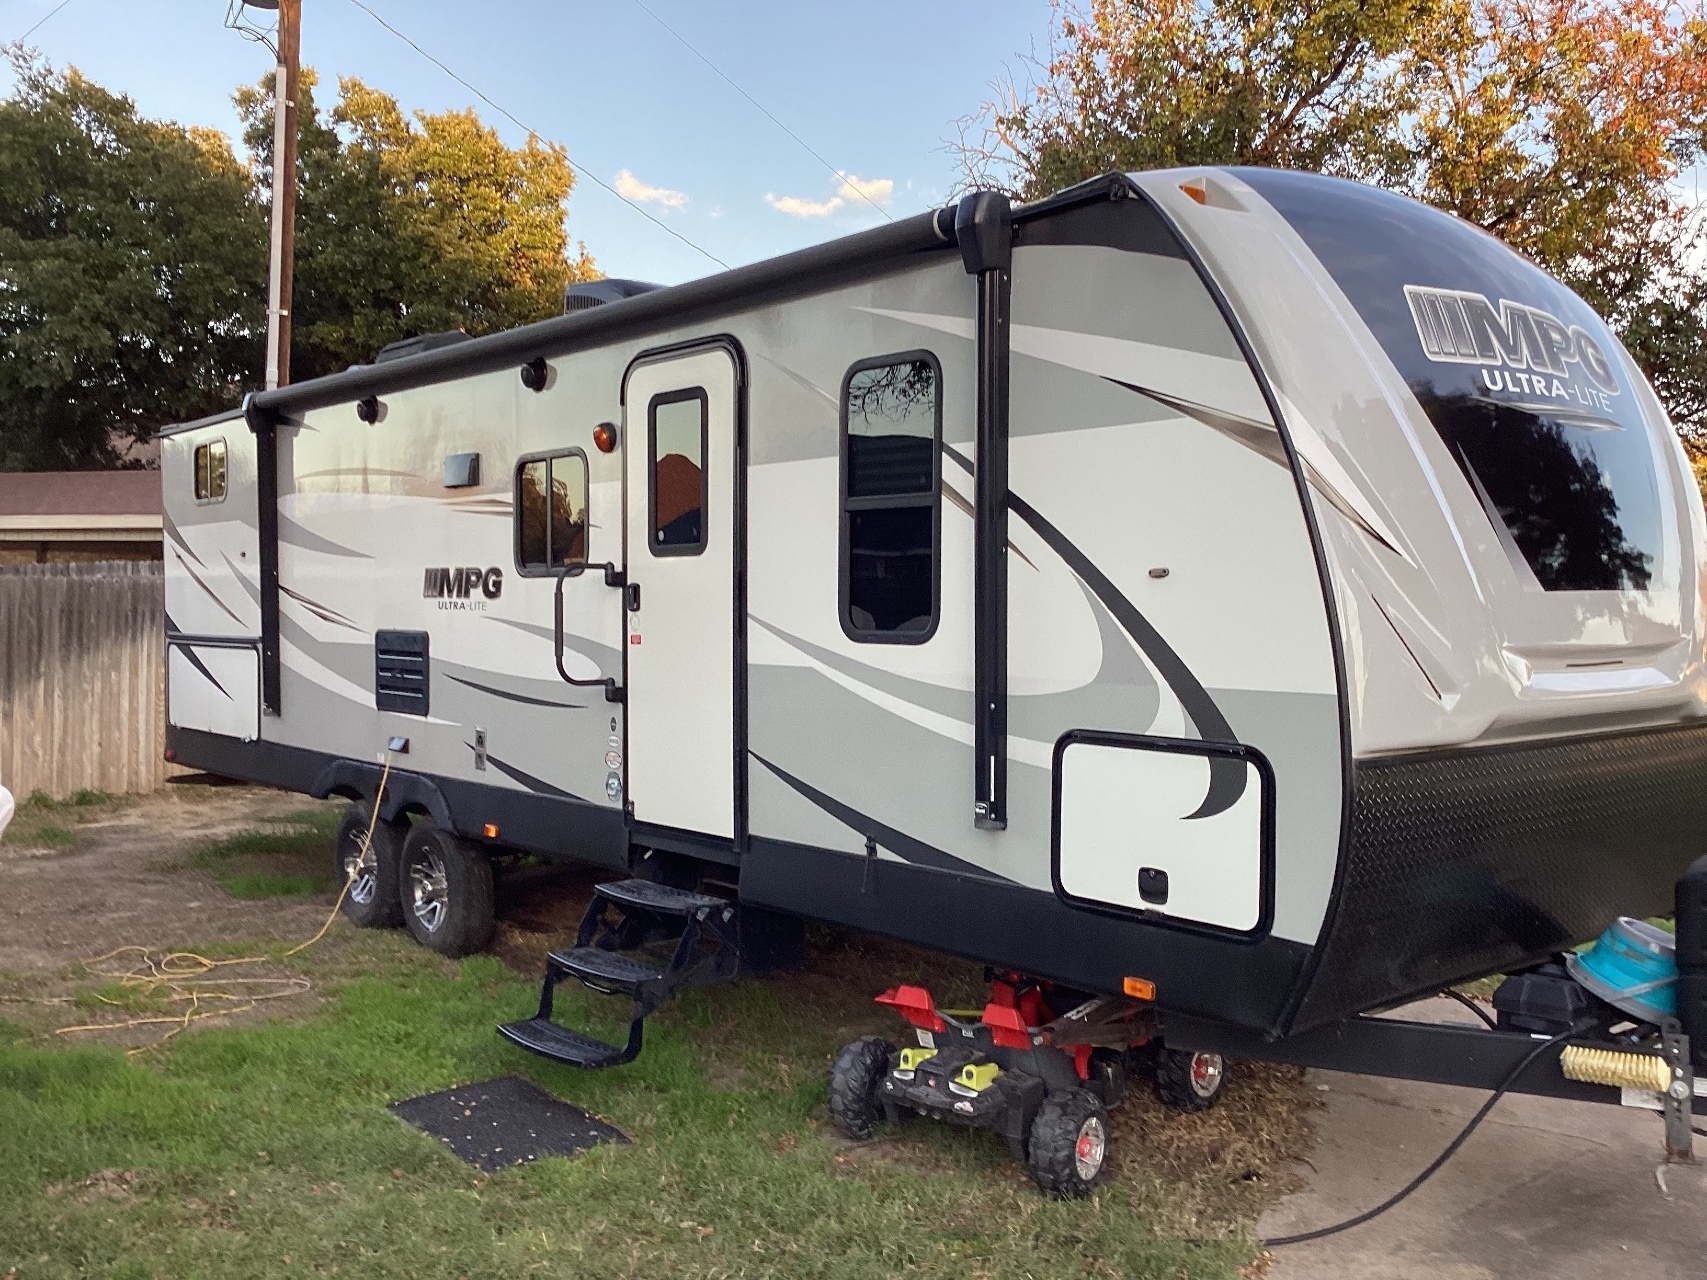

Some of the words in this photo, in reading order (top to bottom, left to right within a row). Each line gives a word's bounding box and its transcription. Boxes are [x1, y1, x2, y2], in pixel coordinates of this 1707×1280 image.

[1456, 291, 1620, 395] MPG
[1481, 368, 1613, 413] ULTRA-LITE
[438, 566, 503, 600] MPG
[437, 601, 488, 611] ULTRA-LITE
